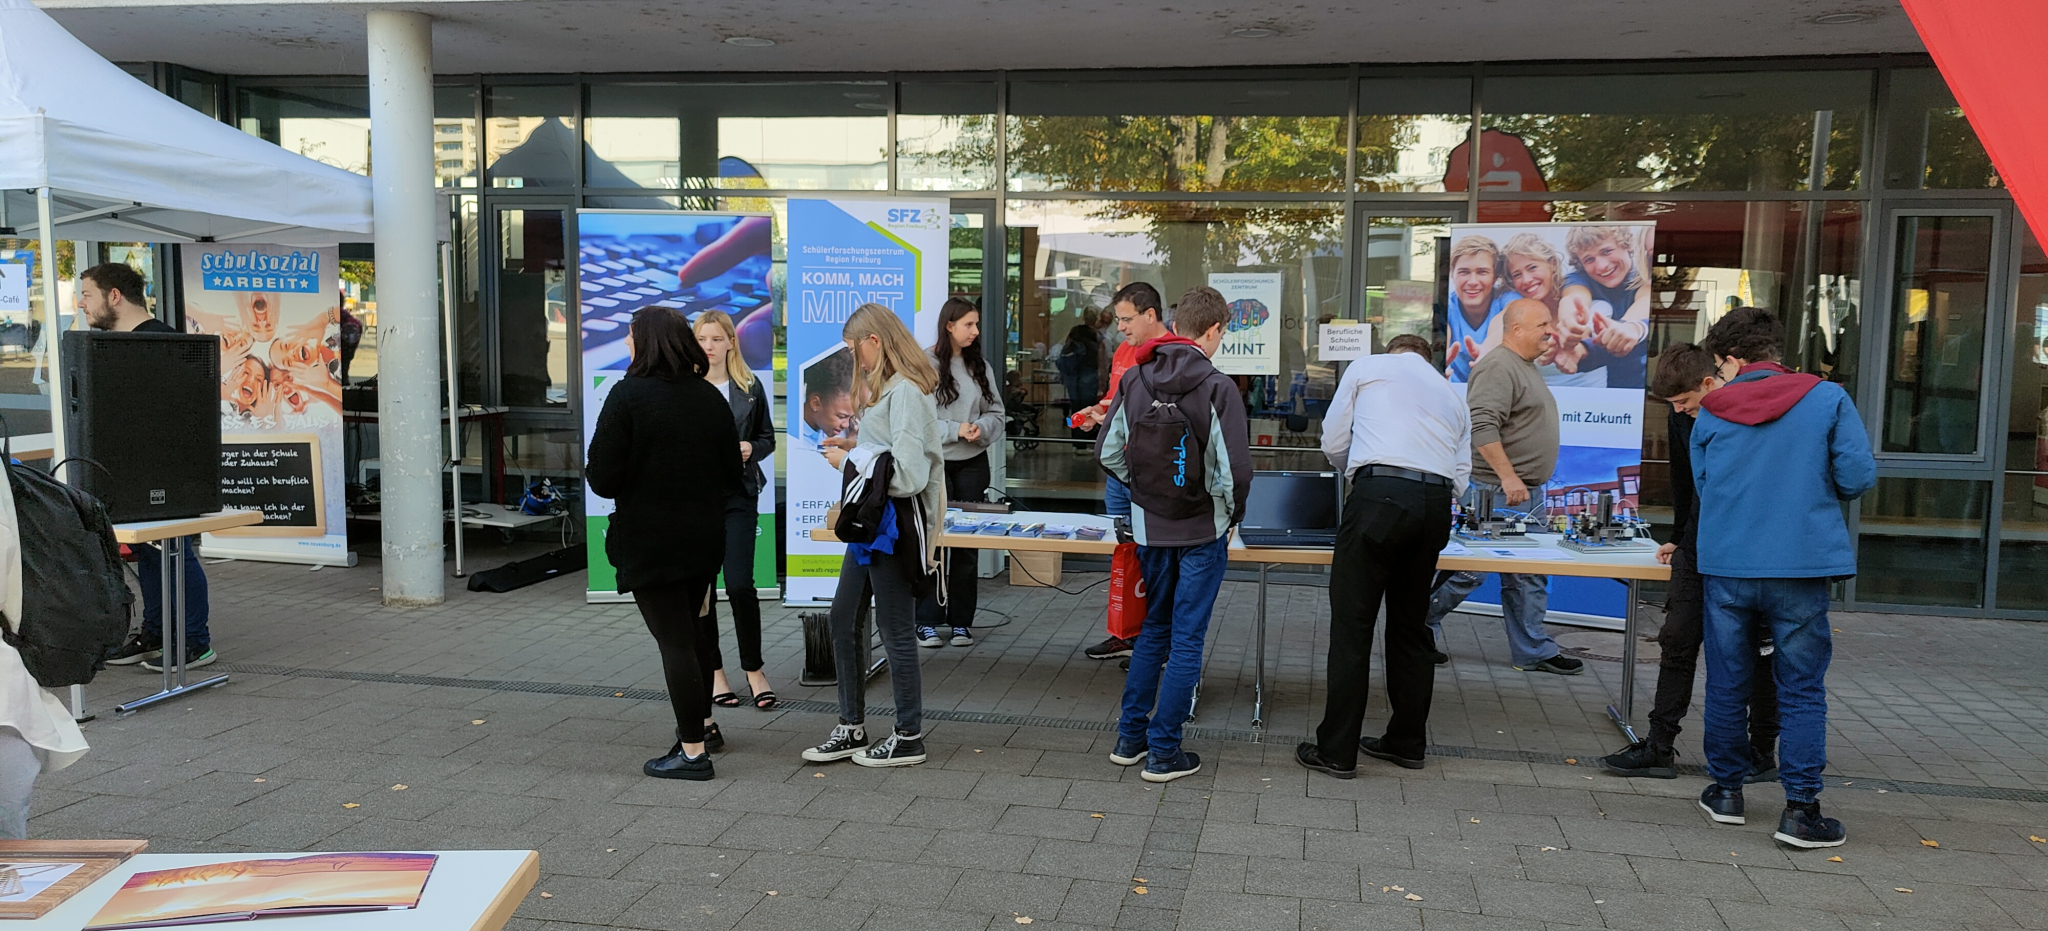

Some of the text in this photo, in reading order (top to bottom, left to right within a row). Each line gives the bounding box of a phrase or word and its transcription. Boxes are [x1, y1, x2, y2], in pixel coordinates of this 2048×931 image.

[887, 208, 921, 223] SFZ
[802, 245, 905, 257] Schülerforschungszentrum
[825, 255, 882, 266] Region Freiburg
[222, 276, 299, 289] ARBEIT
[802, 272, 904, 288] KOMM, MACH
[0, 295, 20, 304] -Café
[1327, 328, 1363, 336] Berufliche
[1330, 336, 1359, 344] Schulen
[1221, 343, 1265, 355] MINT
[1328, 344, 1362, 352] Müllheim
[1562, 412, 1632, 425] mit Zukunft
[221, 449, 299, 460] rger in der Schule
[240, 459, 279, 467] Zuhause?
[237, 477, 253, 485] will
[256, 477, 270, 485] ich
[272, 475, 309, 486] beruflich
[222, 486, 255, 495] machen?
[264, 503, 278, 511] ich
[280, 503, 289, 511] in
[291, 502, 305, 511] der
[802, 530, 811, 538] E
